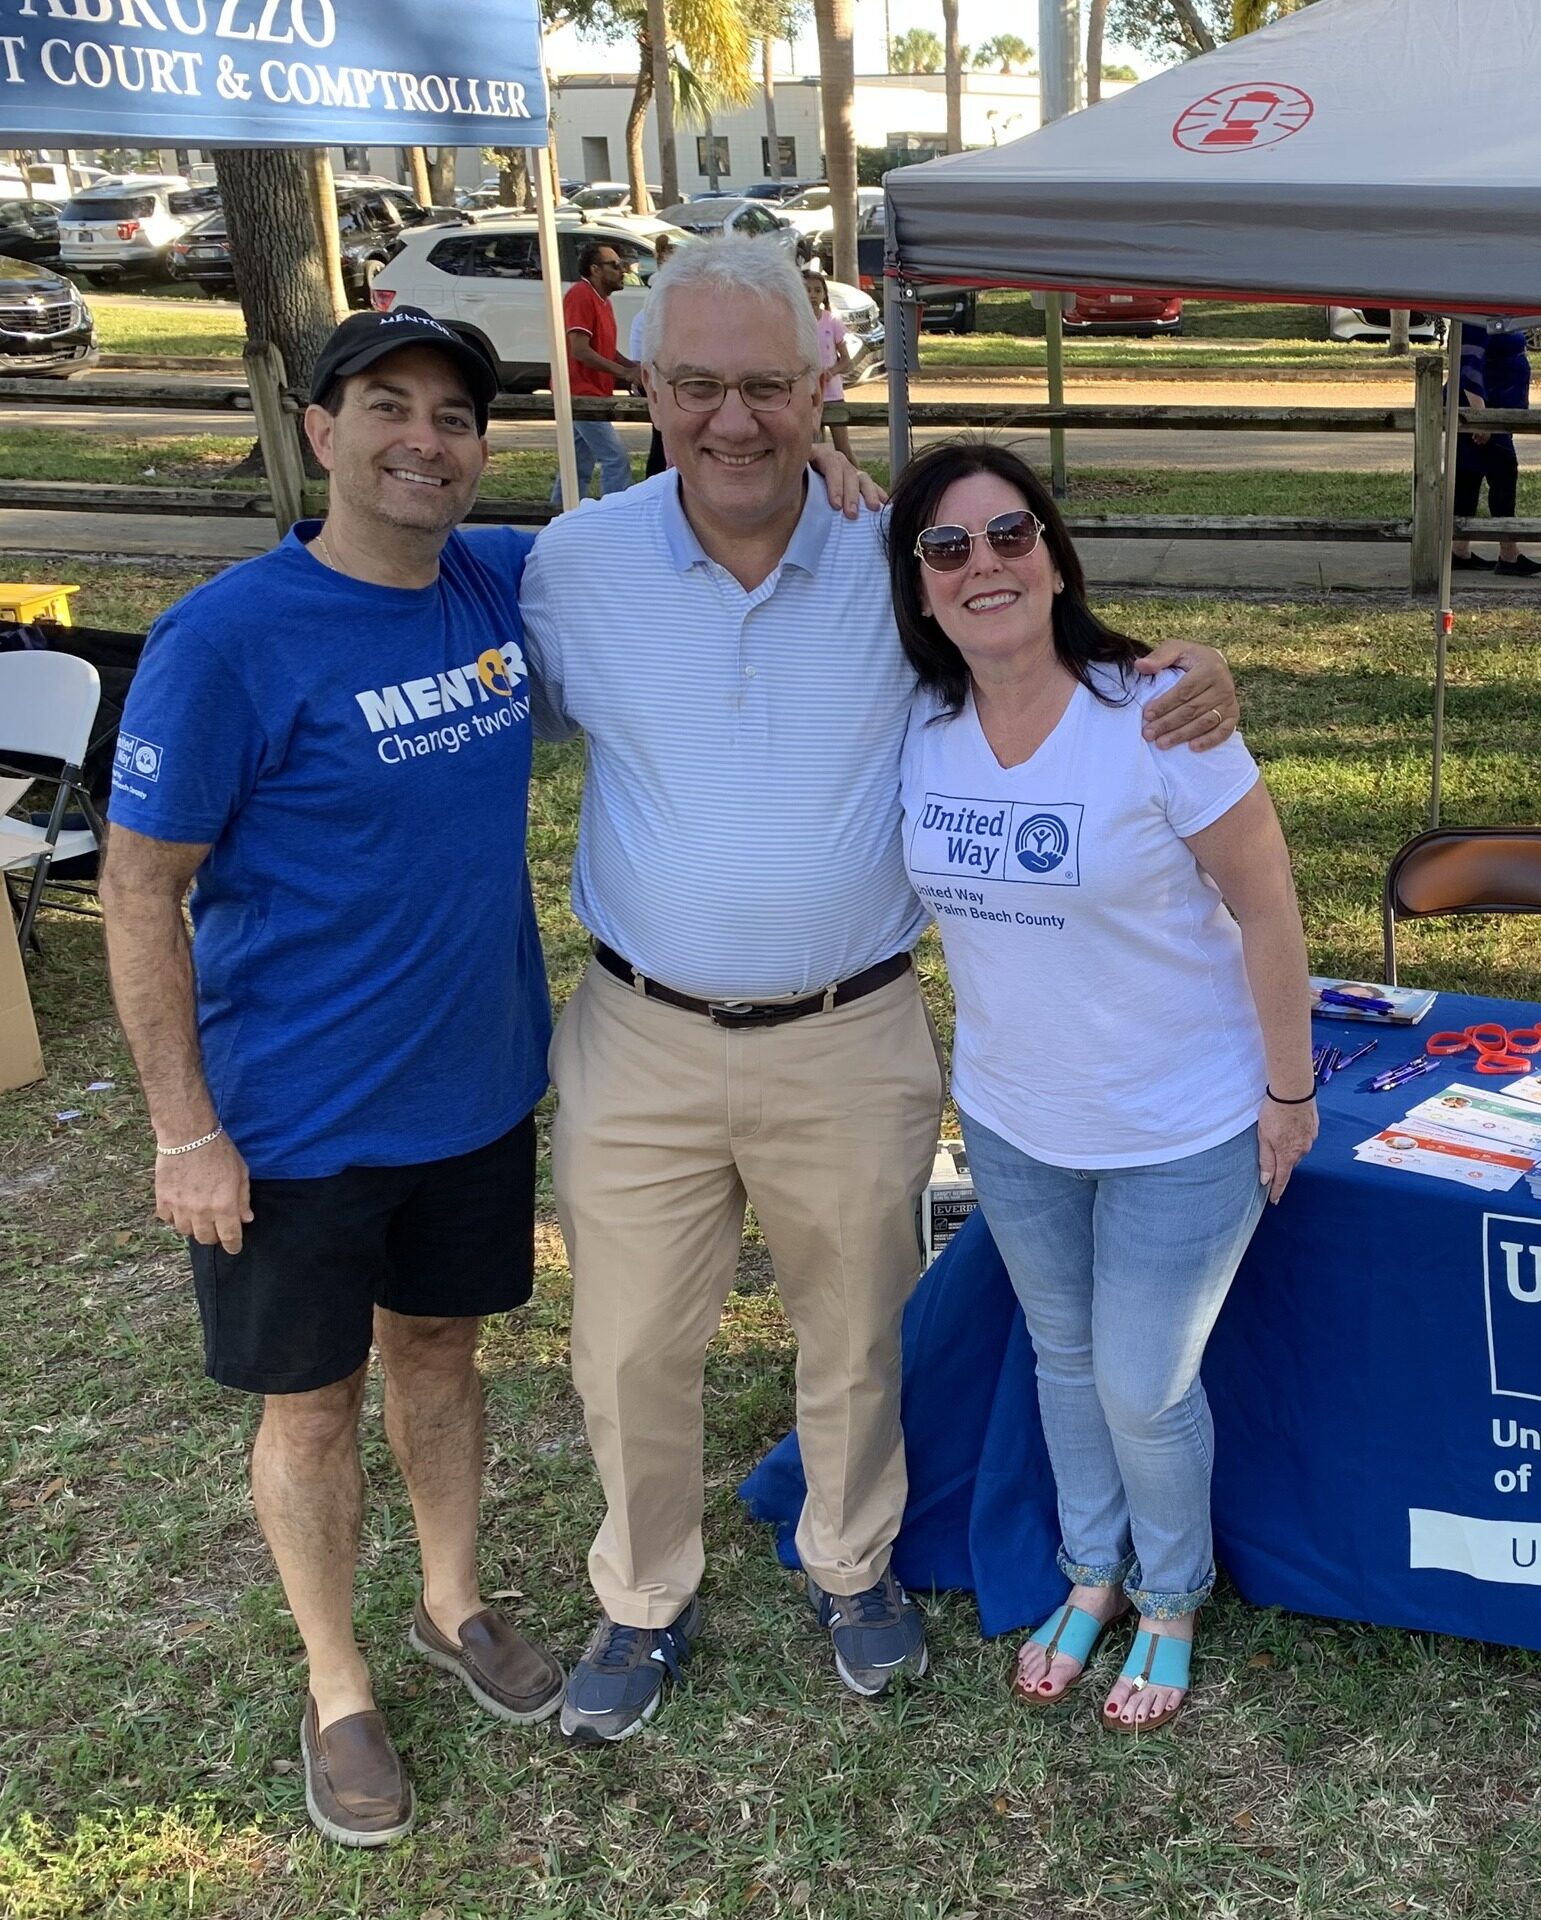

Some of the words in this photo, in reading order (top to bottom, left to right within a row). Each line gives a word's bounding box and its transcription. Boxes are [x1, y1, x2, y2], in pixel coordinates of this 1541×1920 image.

[40, 38, 203, 96] COURT
[215, 54, 252, 101] &
[259, 59, 532, 119] COMPTROLLER
[379, 313, 454, 339] MENTOR
[355, 641, 529, 733] MENTOR
[377, 722, 471, 764] Change
[471, 707, 512, 737] two
[922, 803, 1005, 837] United
[947, 836, 999, 874] Way
[916, 883, 953, 898] United
[954, 888, 984, 905] Way
[934, 902, 967, 917] Palm
[970, 907, 1012, 923] Beach
[1015, 912, 1065, 930] County
[1494, 1463, 1532, 1493] of
